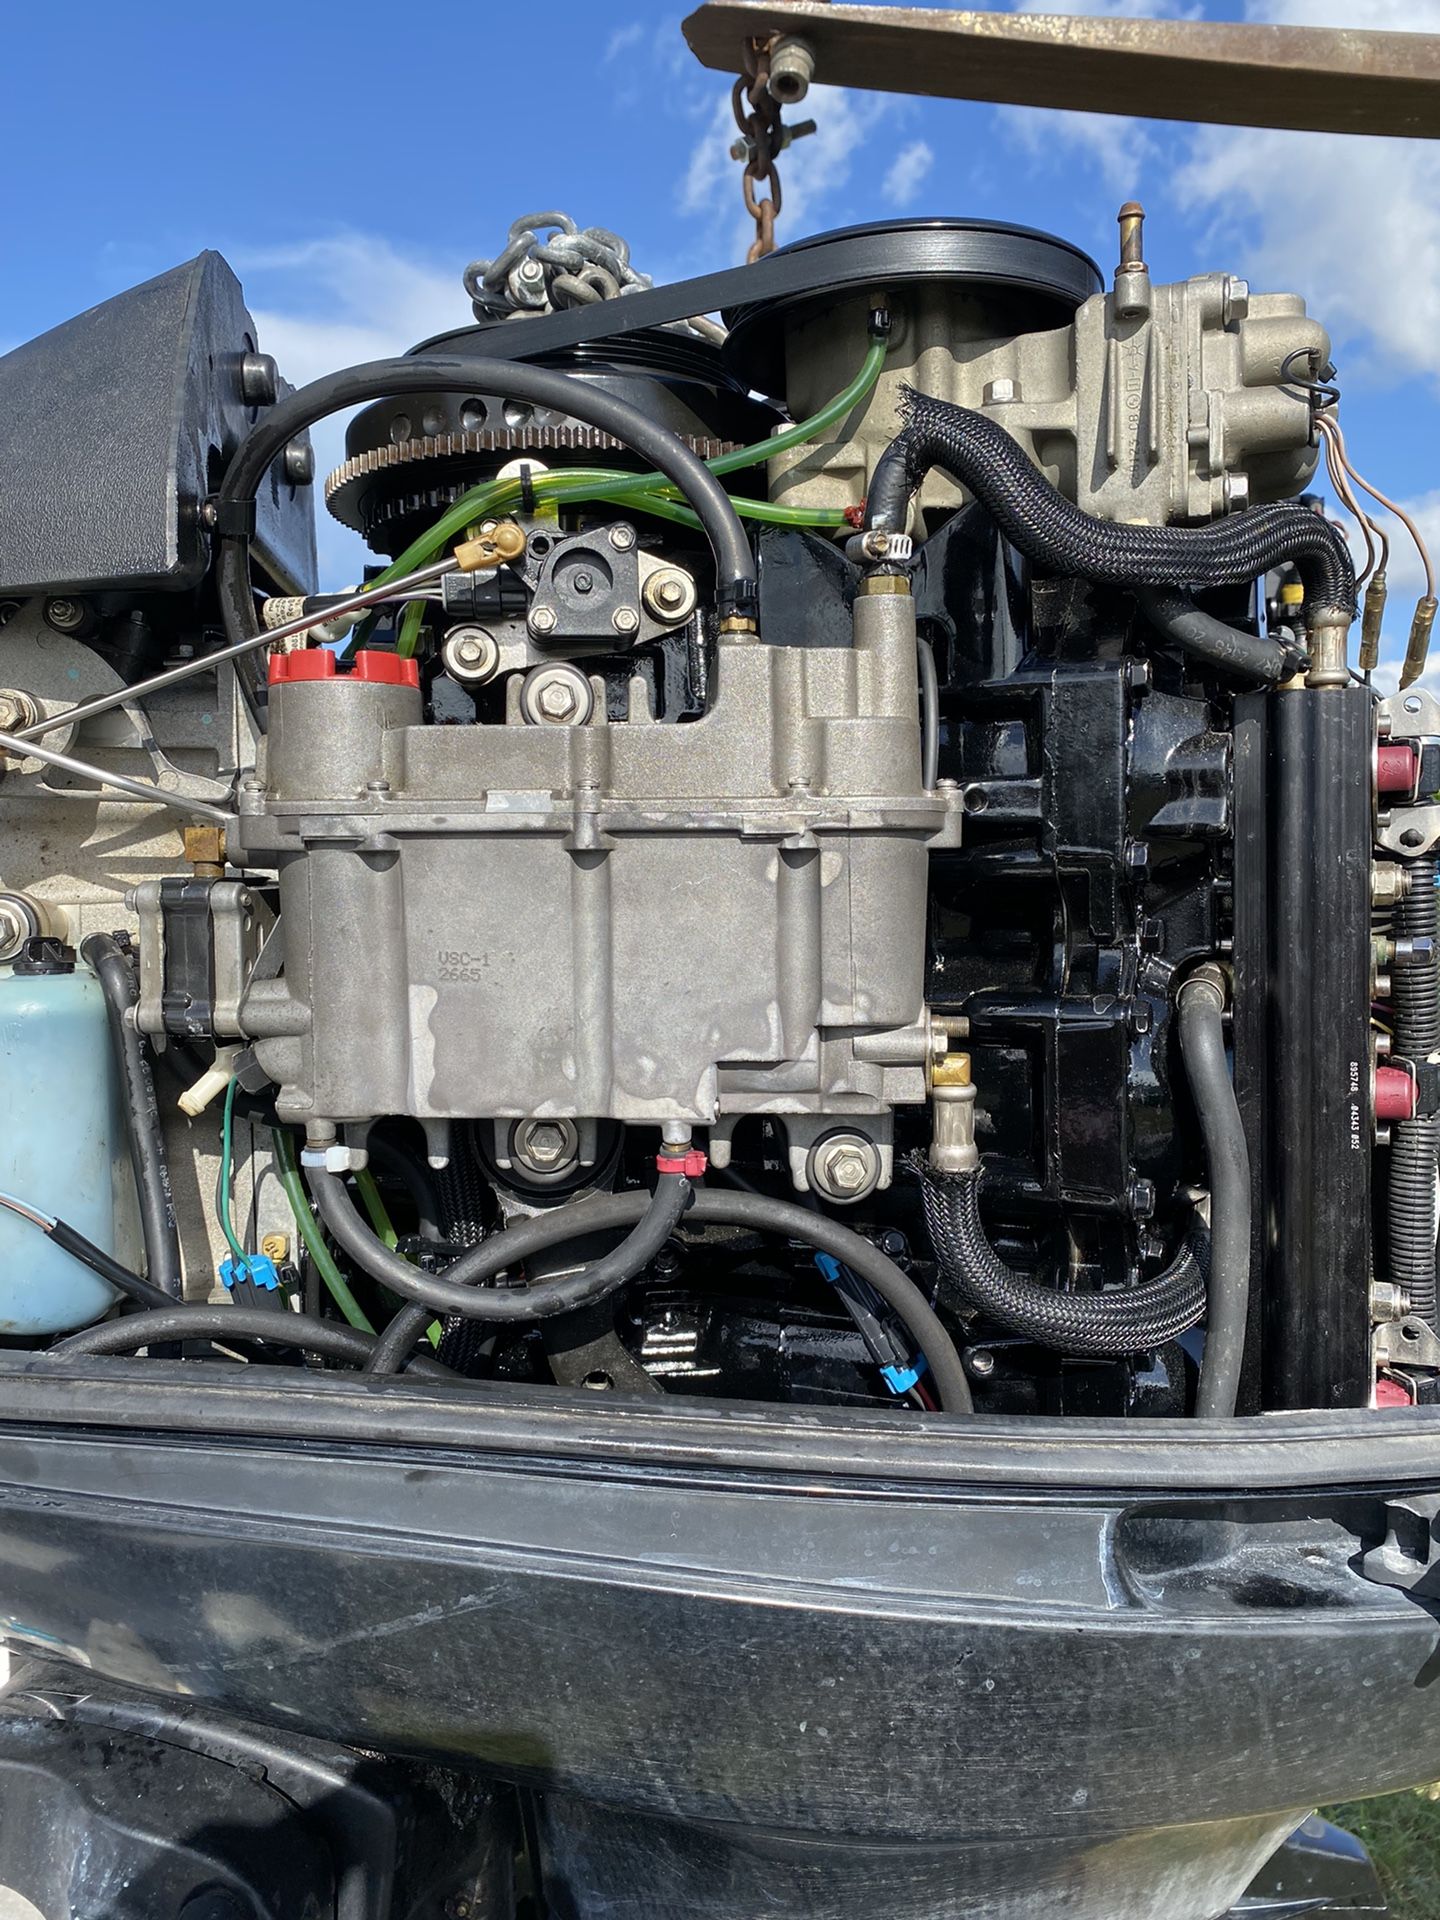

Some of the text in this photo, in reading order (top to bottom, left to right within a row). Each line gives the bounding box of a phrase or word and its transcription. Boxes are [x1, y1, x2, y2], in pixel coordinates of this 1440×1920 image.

[438, 967, 482, 983] 2665
[1350, 1061, 1359, 1092] 895748
[1350, 1133, 1360, 1150] 052
